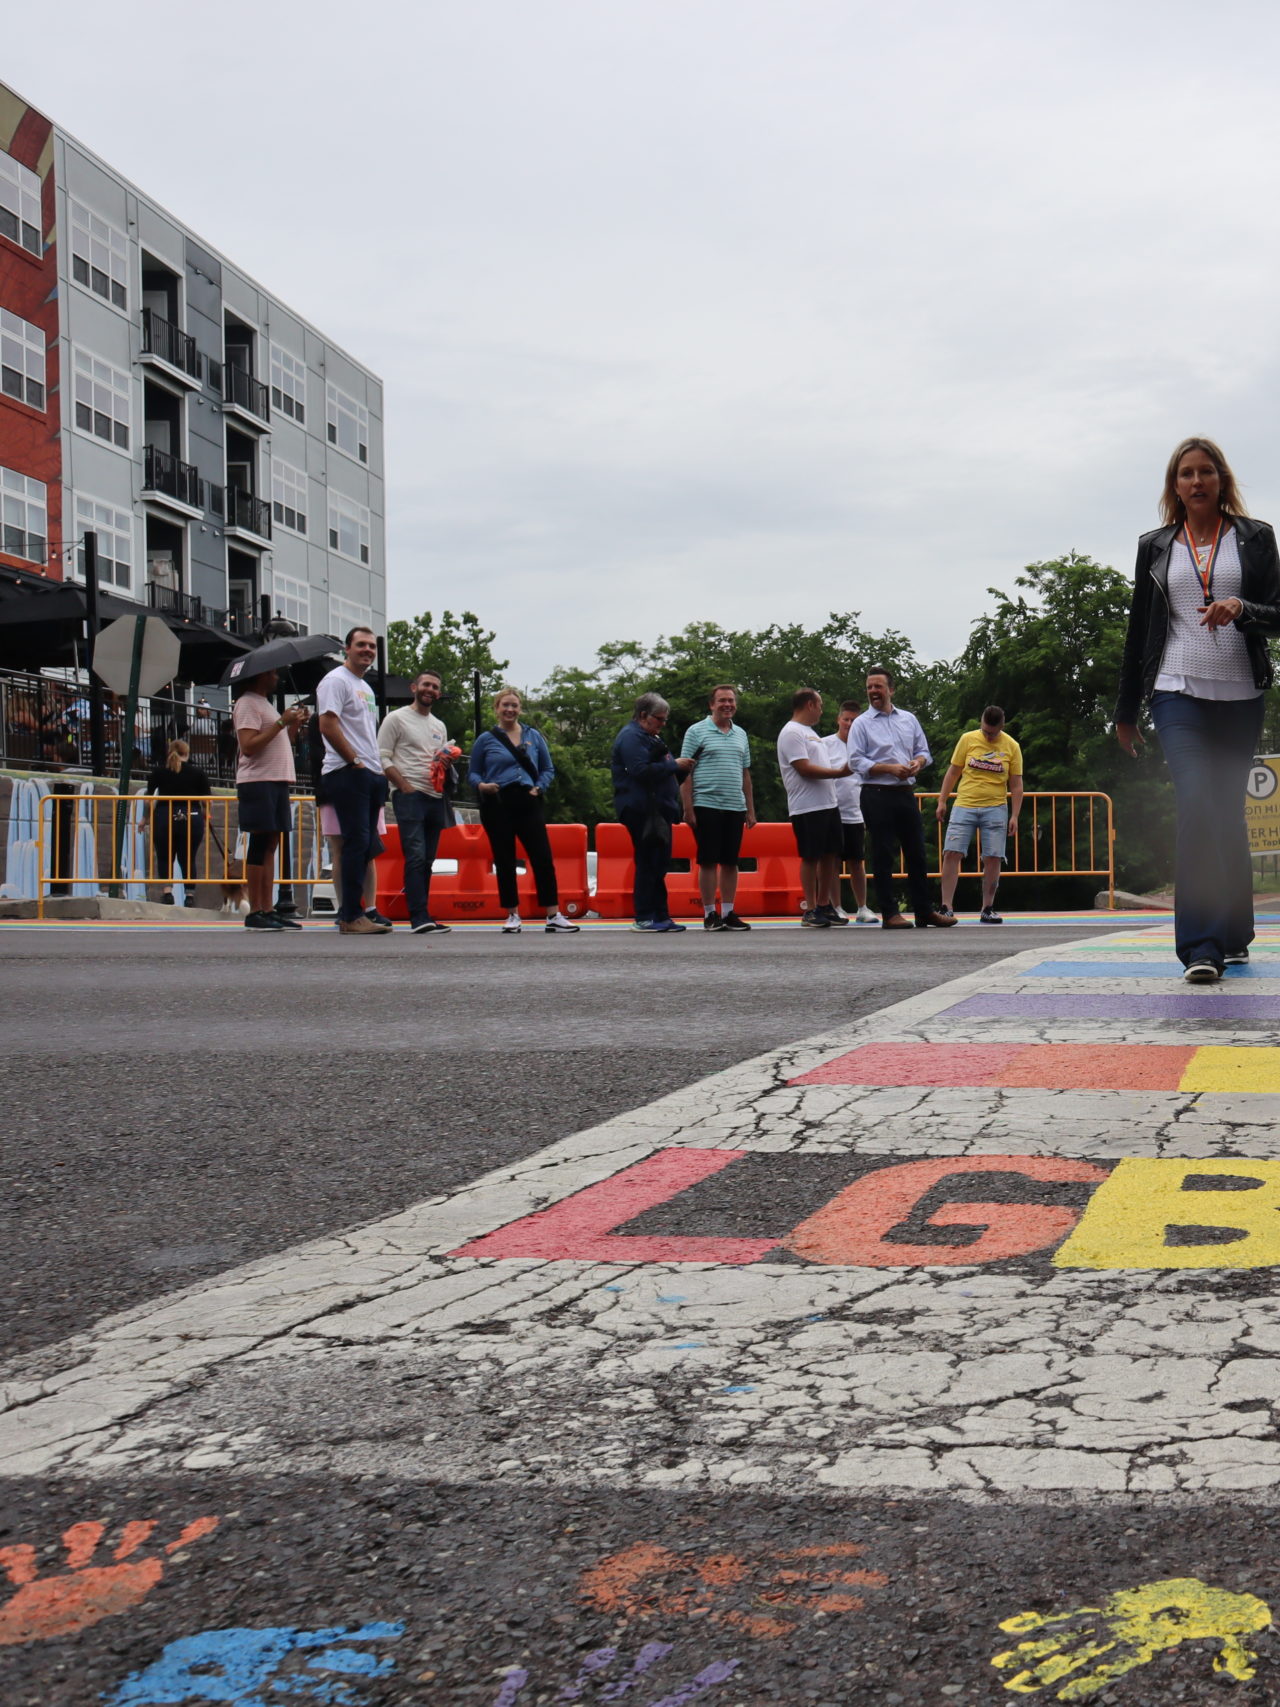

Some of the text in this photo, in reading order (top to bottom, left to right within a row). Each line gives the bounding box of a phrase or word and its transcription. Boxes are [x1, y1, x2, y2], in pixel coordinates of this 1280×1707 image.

[1254, 772, 1268, 793] P
[1244, 805, 1262, 816] ON
[1248, 827, 1266, 839] ER
